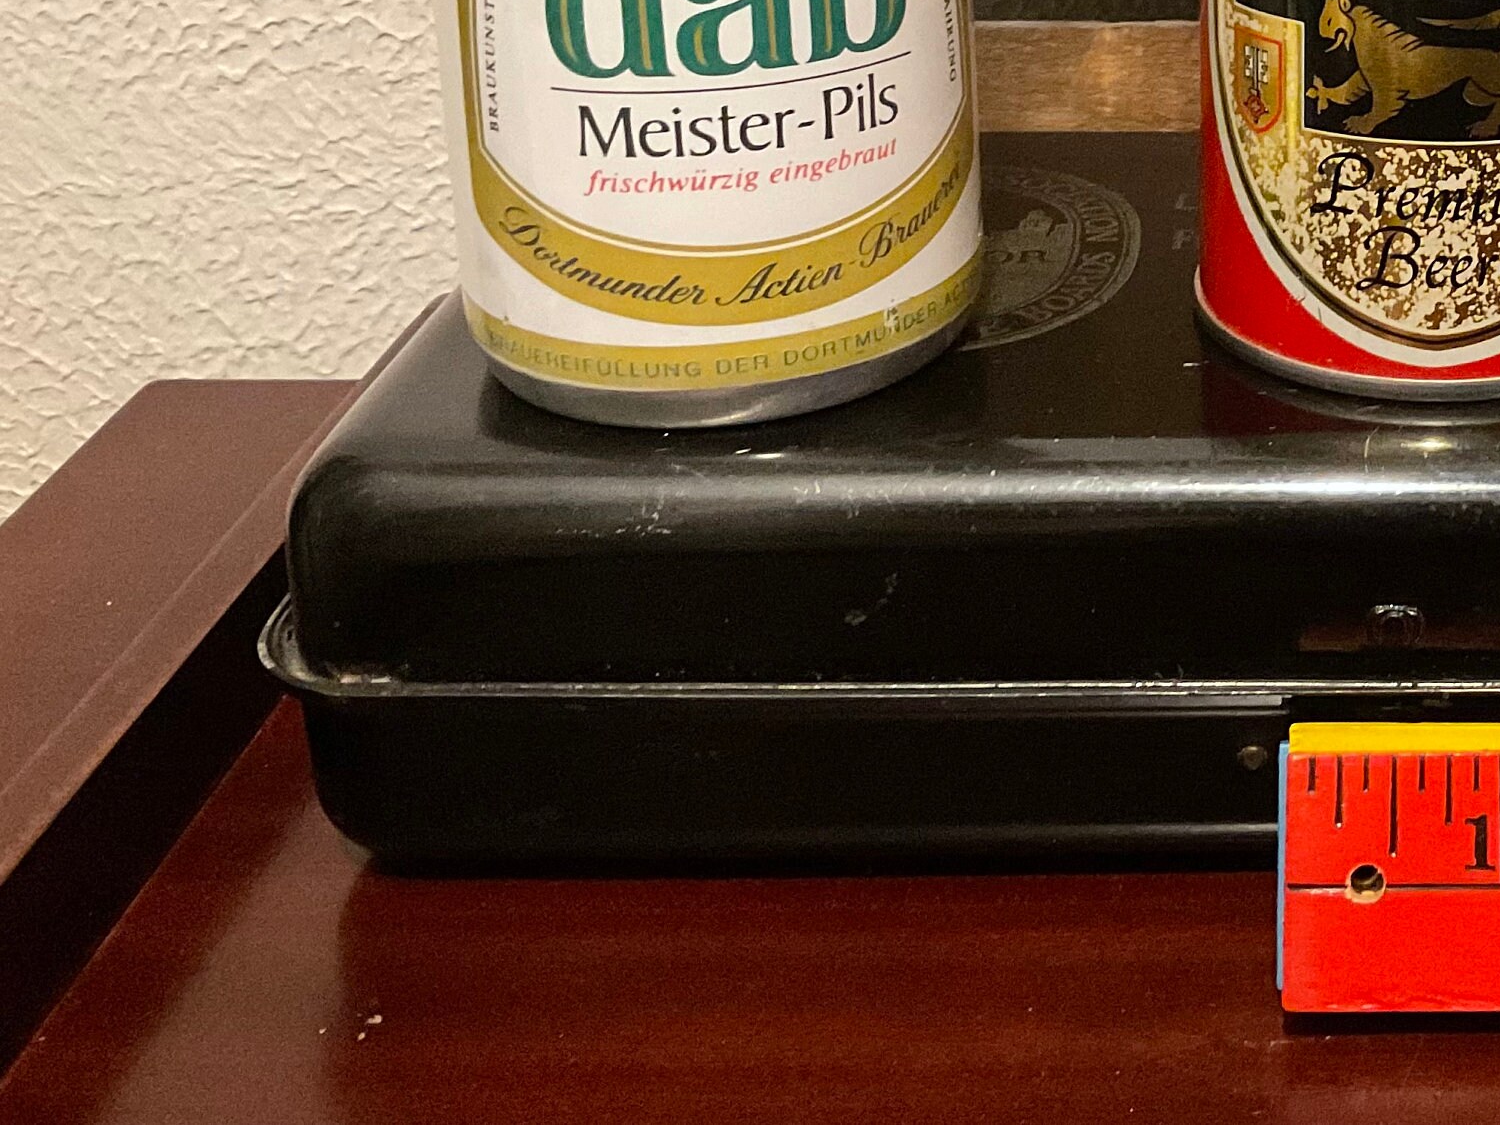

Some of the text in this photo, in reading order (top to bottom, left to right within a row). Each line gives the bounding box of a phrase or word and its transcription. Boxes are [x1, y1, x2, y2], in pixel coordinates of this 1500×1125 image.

[578, 73, 900, 159] Meister-Pils
[584, 138, 897, 197] frischwürzig eingebraut
[498, 206, 708, 305] Dortmunder
[1355, 226, 1499, 290] Beer
[715, 353, 769, 375] DER
[1464, 815, 1496, 871] 1
